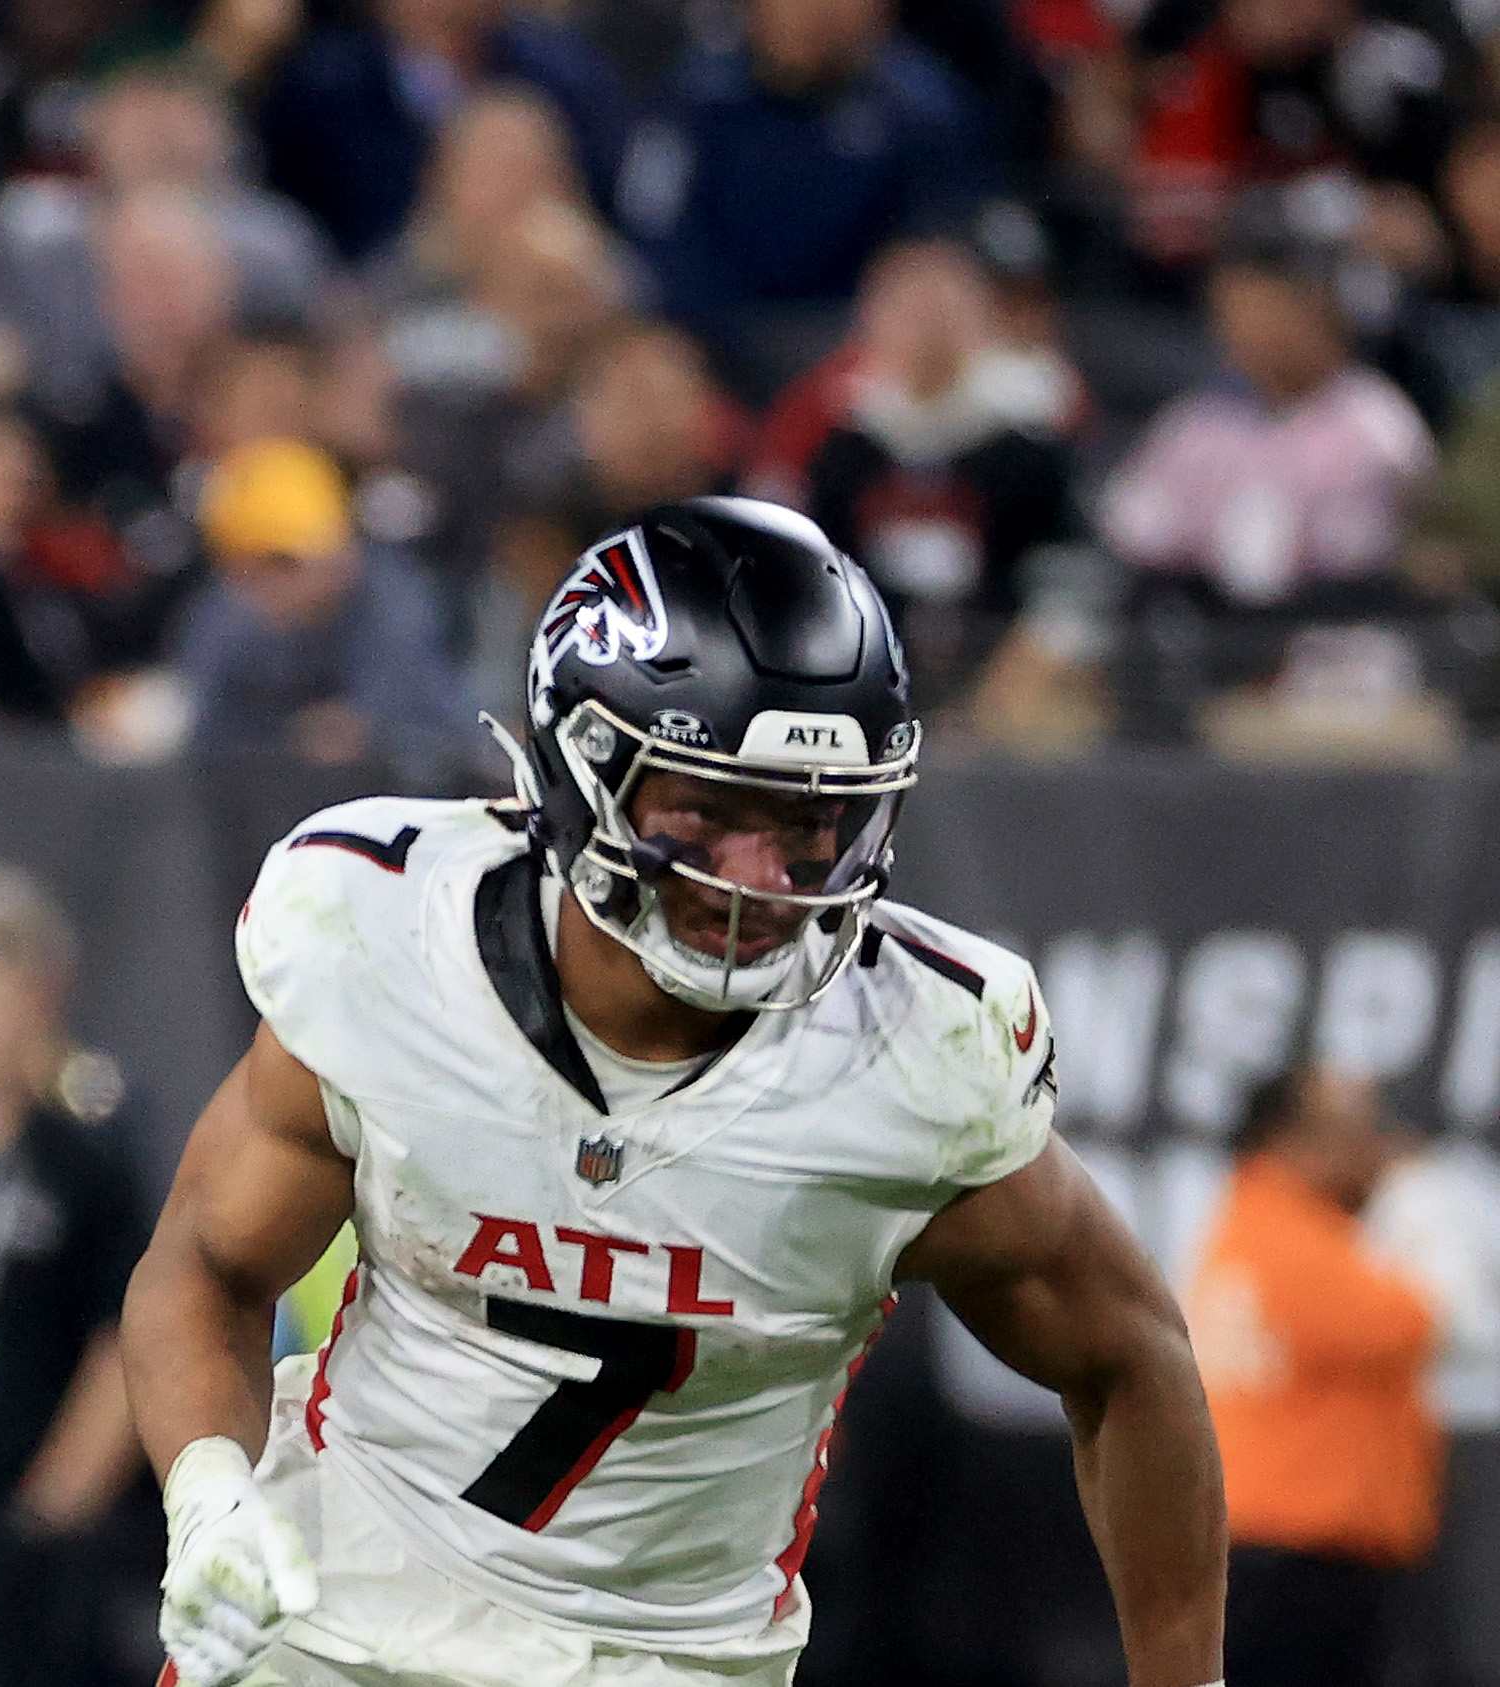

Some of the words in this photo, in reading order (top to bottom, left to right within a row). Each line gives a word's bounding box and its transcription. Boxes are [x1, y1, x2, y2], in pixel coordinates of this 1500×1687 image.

[784, 724, 844, 749] ATL
[453, 1211, 735, 1316] ATL
[459, 1294, 697, 1533] 7
